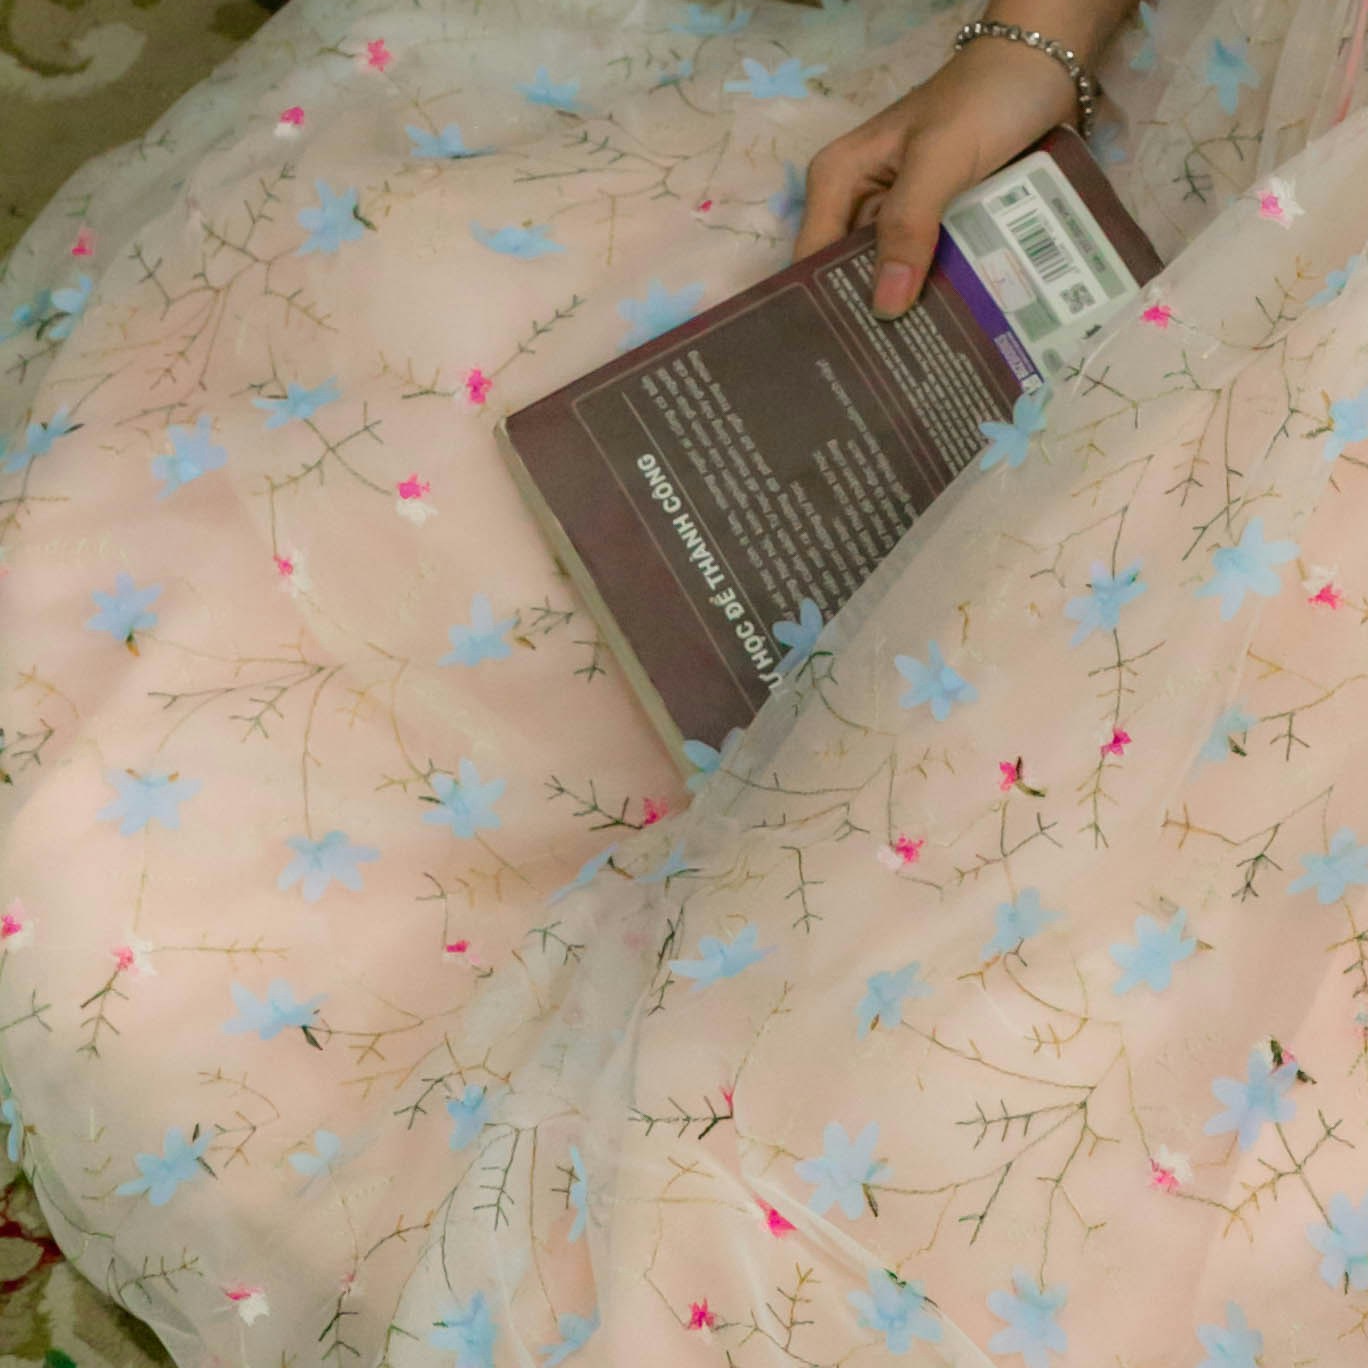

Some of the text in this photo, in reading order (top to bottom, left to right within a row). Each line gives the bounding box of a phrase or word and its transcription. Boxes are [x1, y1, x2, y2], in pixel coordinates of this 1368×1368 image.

[632, 450, 683, 517] CÔNG
[668, 511, 727, 592] THÀNH
[708, 585, 746, 626] ĐỂ
[732, 615, 778, 670] HỌC
